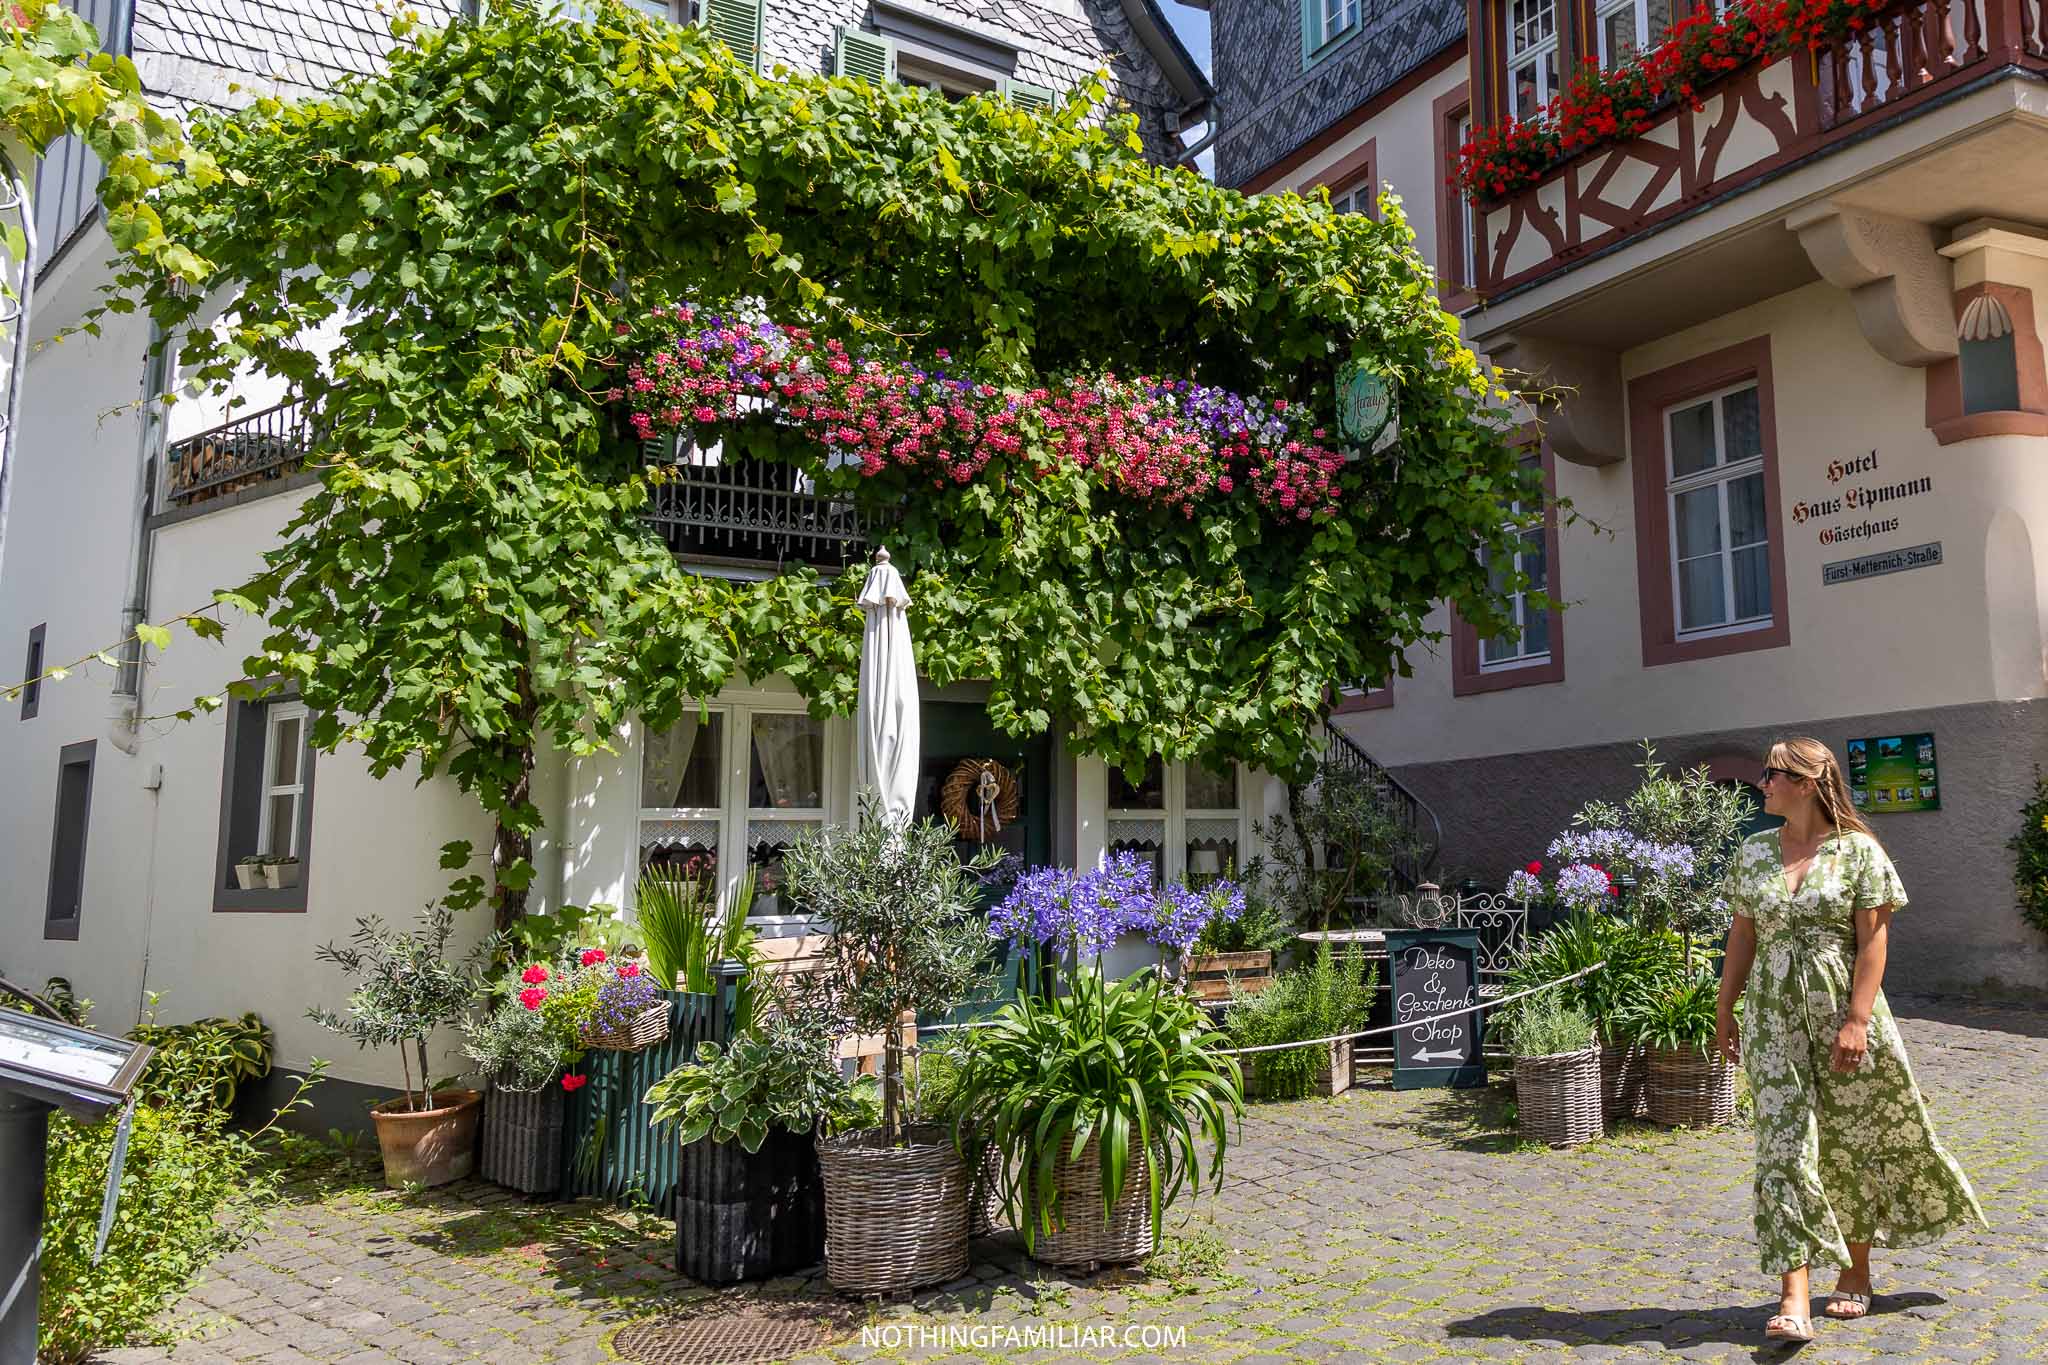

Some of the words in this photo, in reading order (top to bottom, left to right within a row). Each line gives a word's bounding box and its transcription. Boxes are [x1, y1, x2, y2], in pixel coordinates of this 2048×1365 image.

[1827, 448, 1878, 486] Hotel
[1792, 496, 1842, 525] Haus
[1845, 475, 1932, 511] Lipmann
[1819, 516, 1899, 546] Gästehaus
[1404, 945, 1456, 970] Deko
[1423, 971, 1443, 993] &
[1397, 985, 1474, 1023] Geschenk
[1411, 1015, 1463, 1045] Shop
